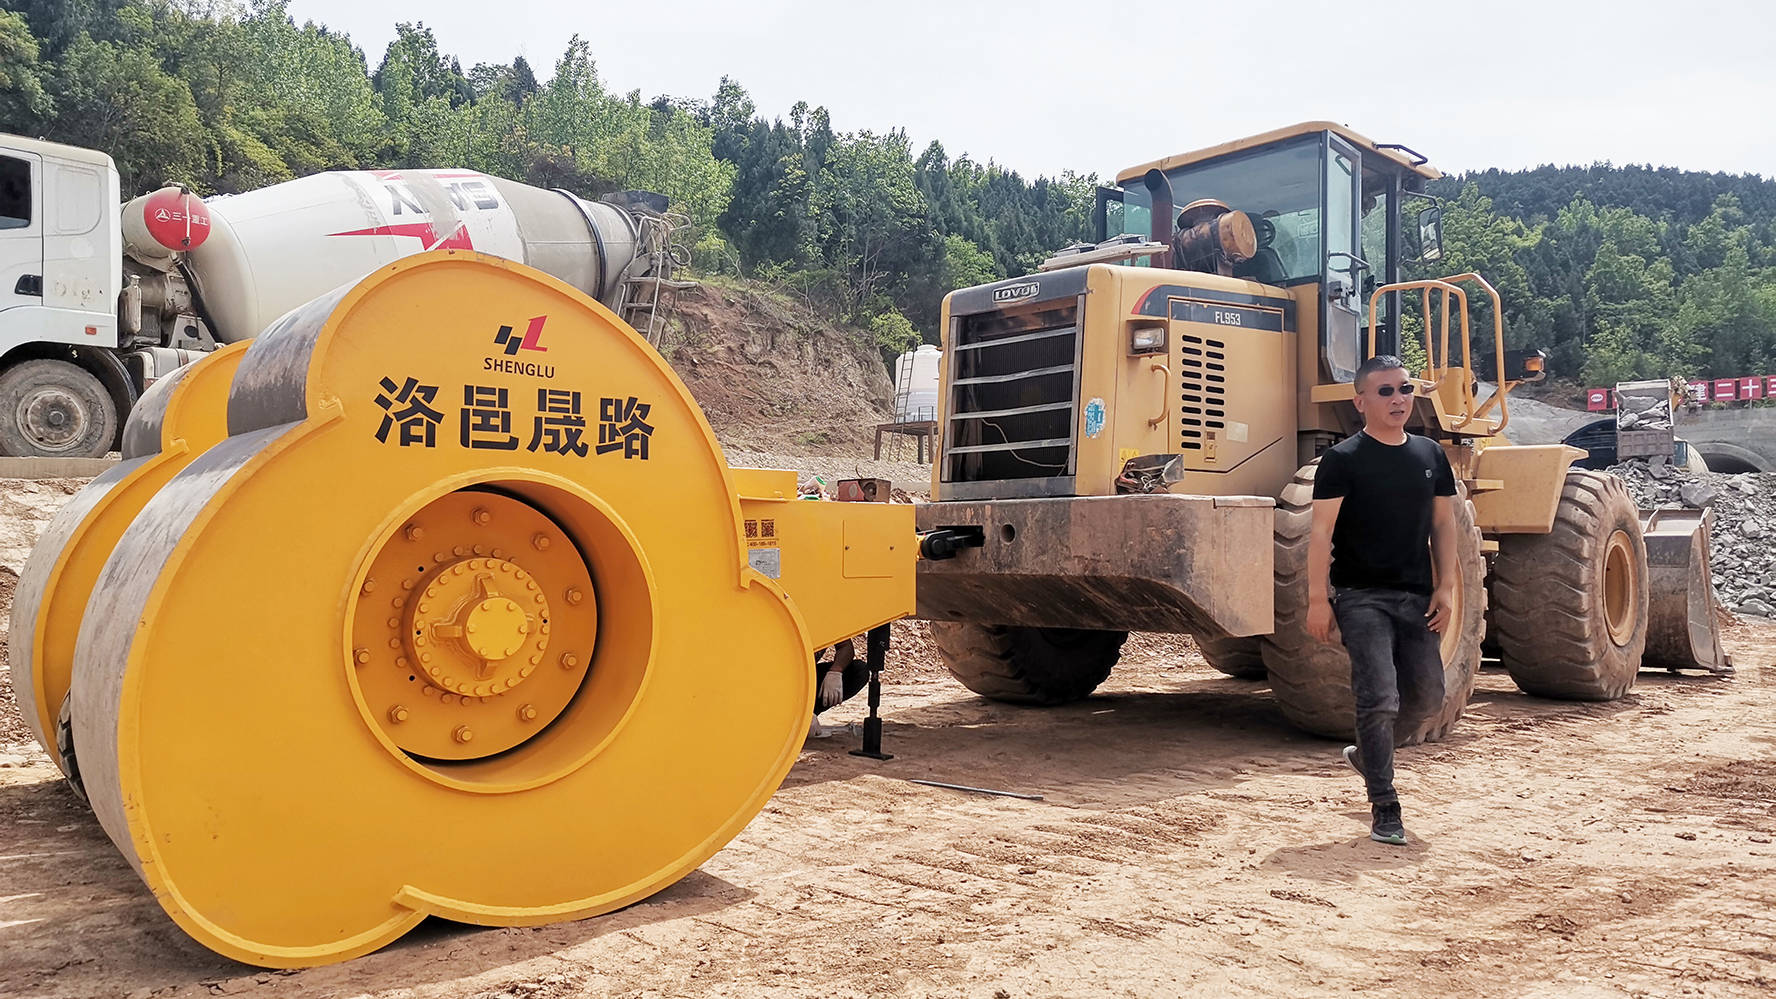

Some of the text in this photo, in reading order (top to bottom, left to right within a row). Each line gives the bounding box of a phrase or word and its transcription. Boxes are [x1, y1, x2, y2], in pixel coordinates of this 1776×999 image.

[1214, 311, 1241, 325] FL953
[483, 357, 555, 379] SHENGLU
[374, 376, 655, 460] 洛邑晟路
